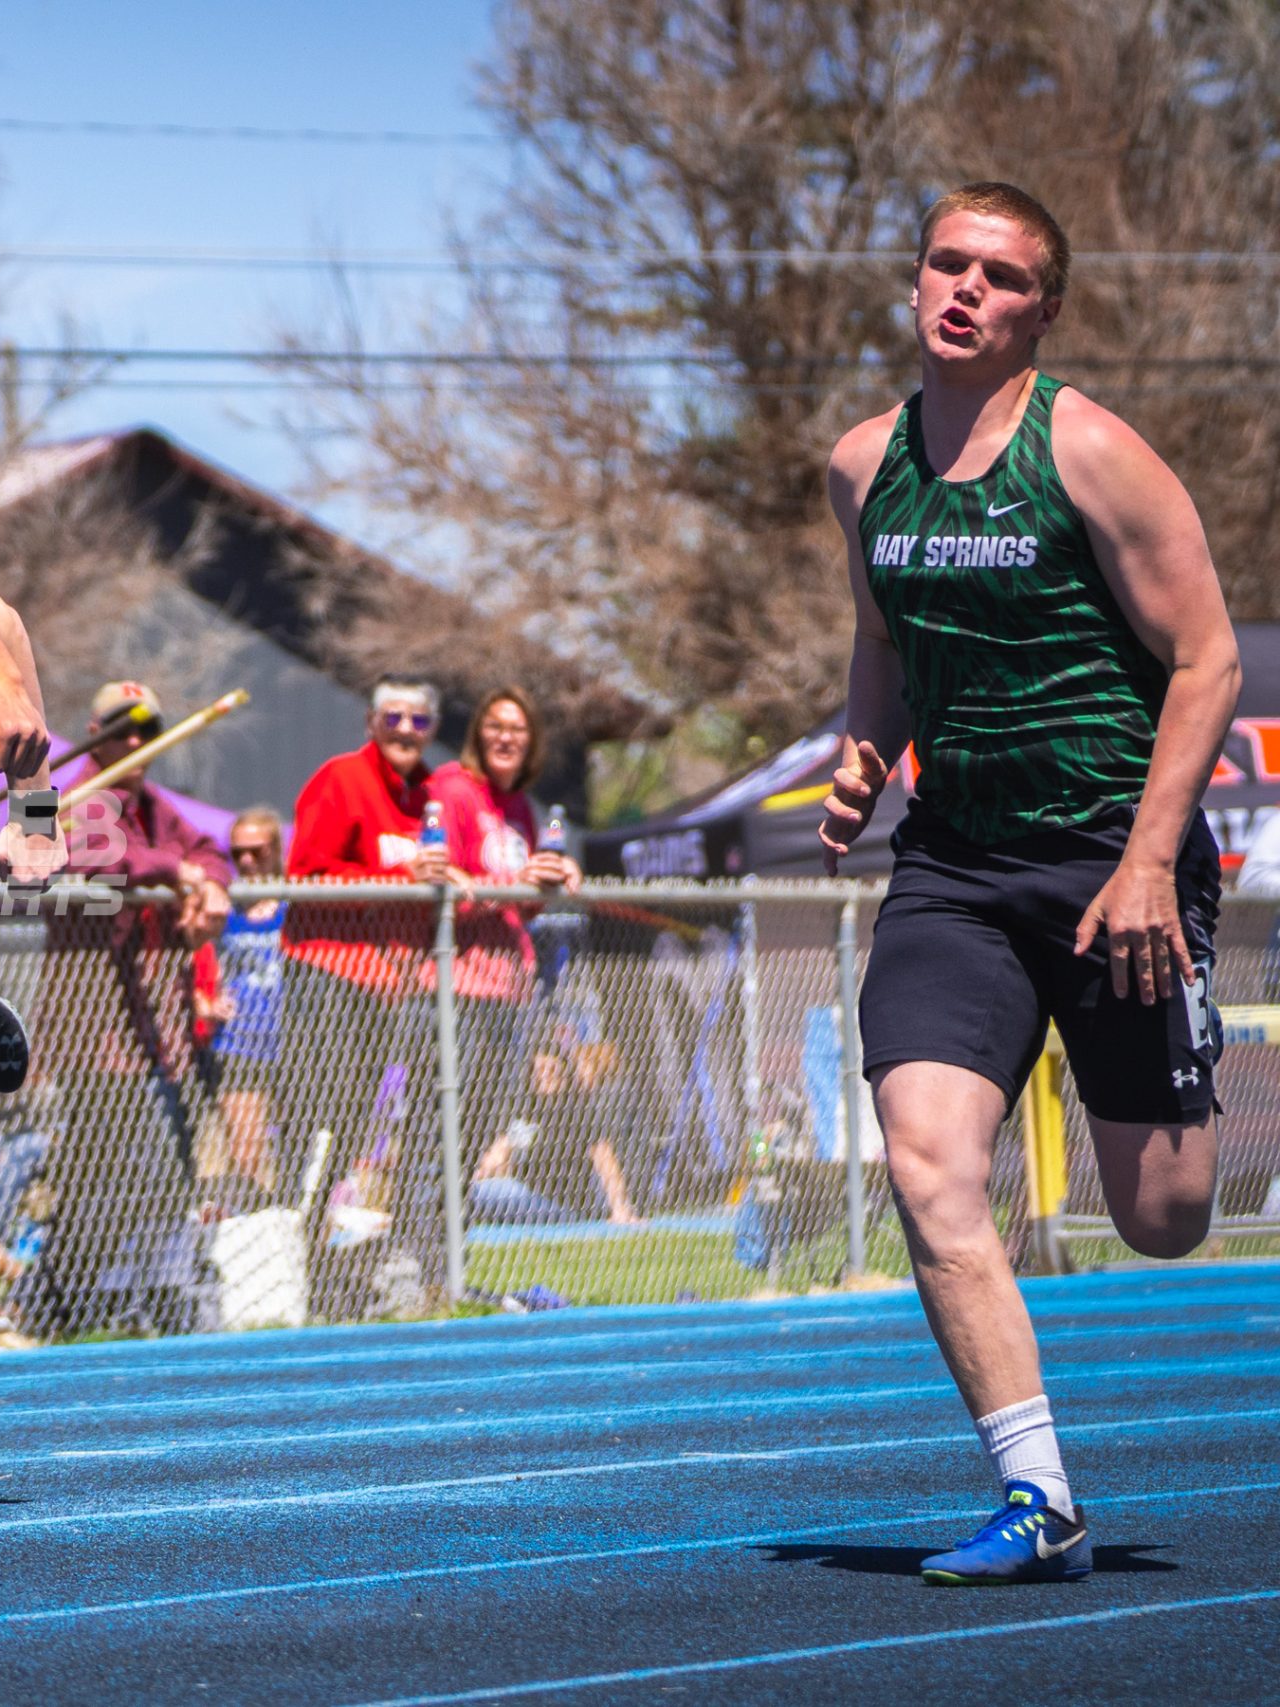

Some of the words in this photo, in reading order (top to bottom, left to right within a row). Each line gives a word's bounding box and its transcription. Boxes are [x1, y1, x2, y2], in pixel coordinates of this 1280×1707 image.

[872, 534, 919, 565] HAY
[924, 536, 1039, 567] SPRINGS
[1193, 965, 1210, 1041] 3
